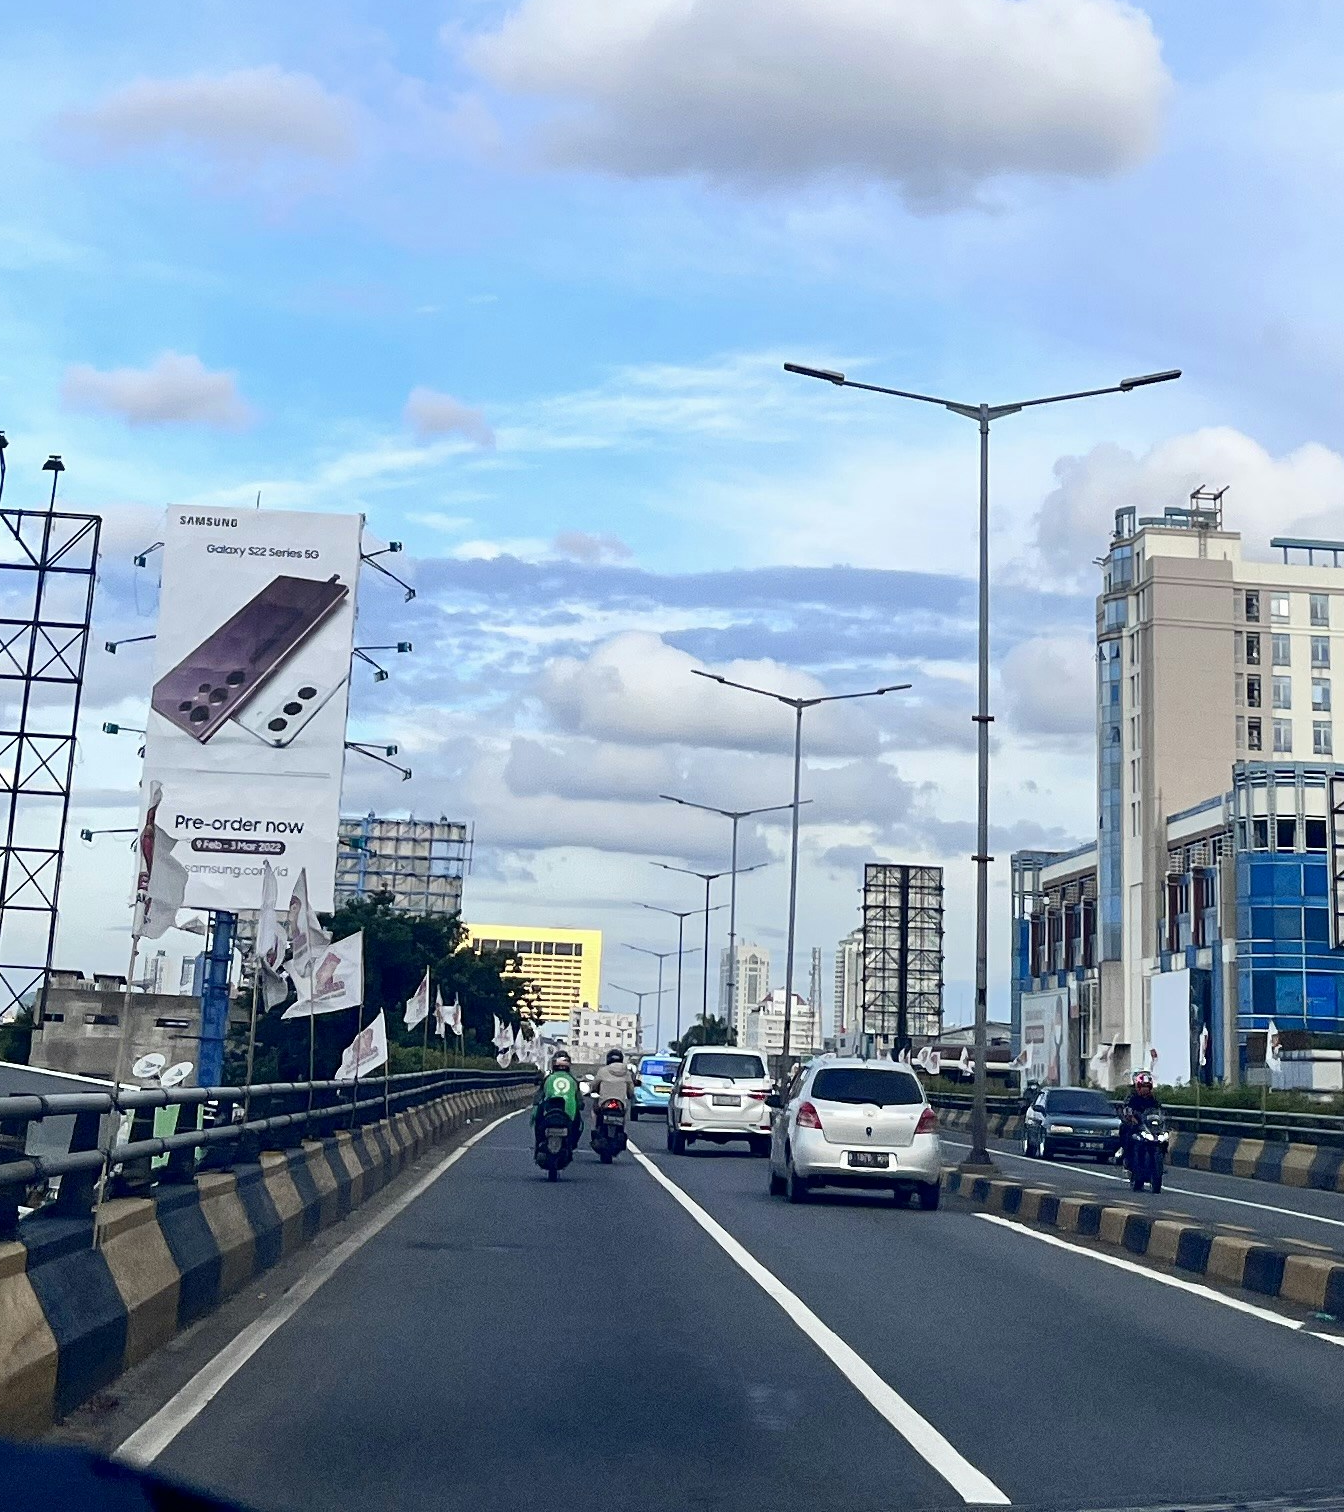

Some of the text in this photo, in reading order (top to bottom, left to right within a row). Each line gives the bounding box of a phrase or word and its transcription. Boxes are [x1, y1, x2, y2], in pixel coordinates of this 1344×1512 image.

[179, 515, 238, 528] SAMSUNG
[206, 544, 320, 559] Galaxy S22 Series 5G
[174, 814, 305, 834] Pre-order now
[203, 840, 223, 849] Feb
[230, 841, 236, 850] 3
[237, 841, 258, 851] Mar
[258, 842, 282, 852] 2022
